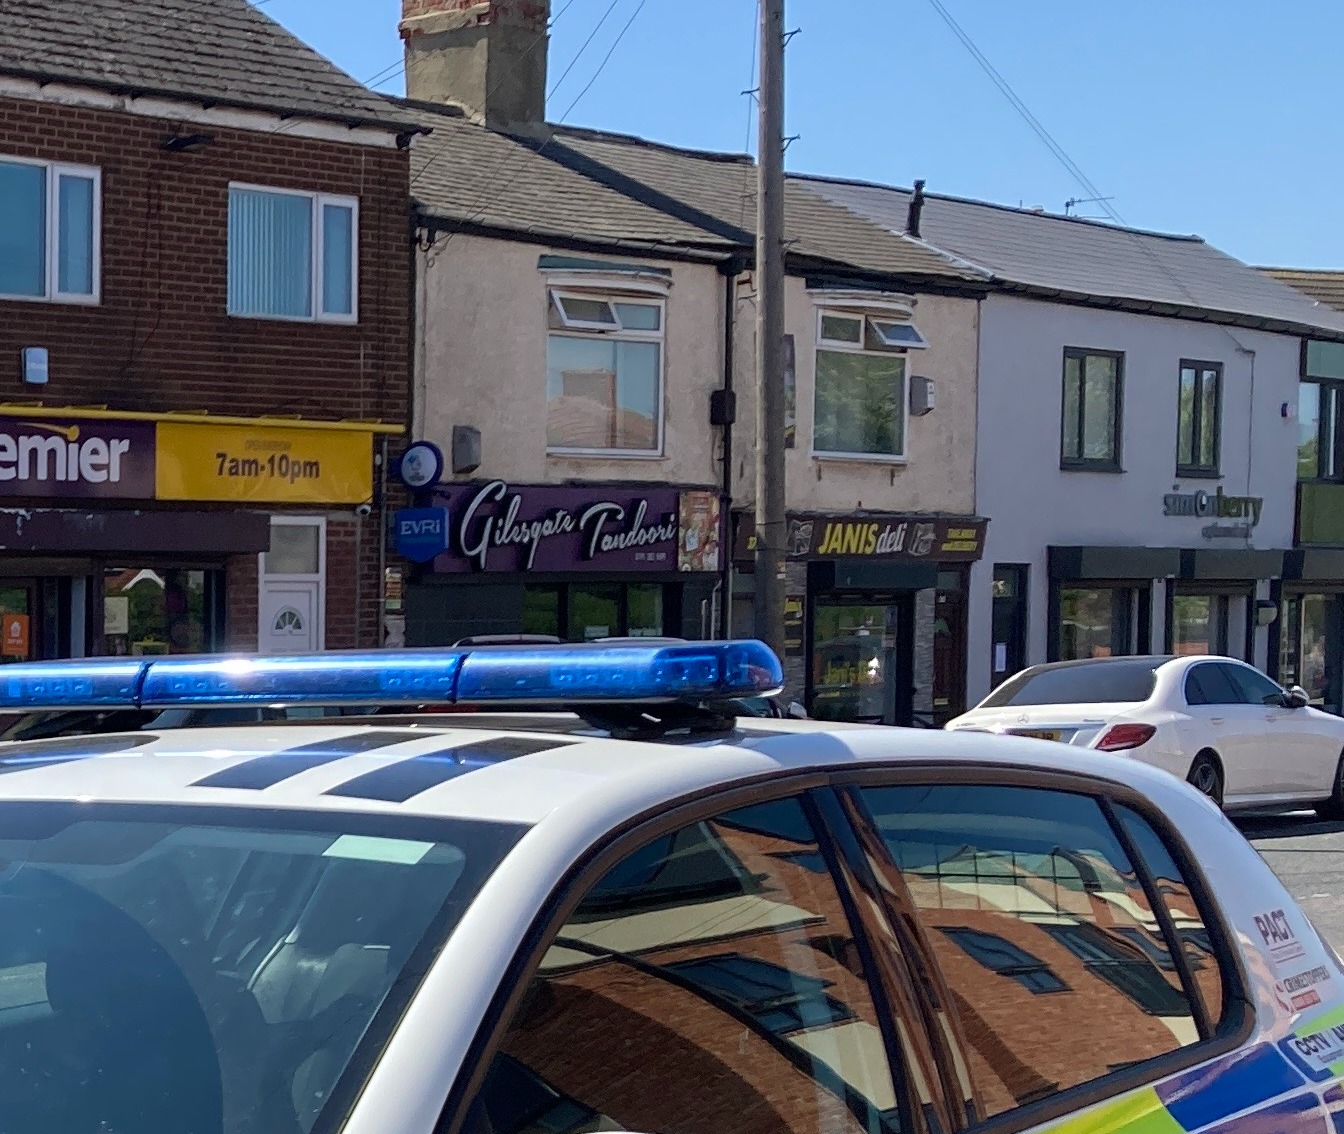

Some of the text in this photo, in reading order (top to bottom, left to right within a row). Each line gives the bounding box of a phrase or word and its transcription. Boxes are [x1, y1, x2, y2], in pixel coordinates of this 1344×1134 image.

[400, 518, 441, 536] EVRI
[462, 480, 677, 570] Gilesgate Tandoori
[817, 521, 909, 555] JANIS deli
[1253, 909, 1295, 946] PACT
[1294, 1032, 1332, 1056] CCTV
